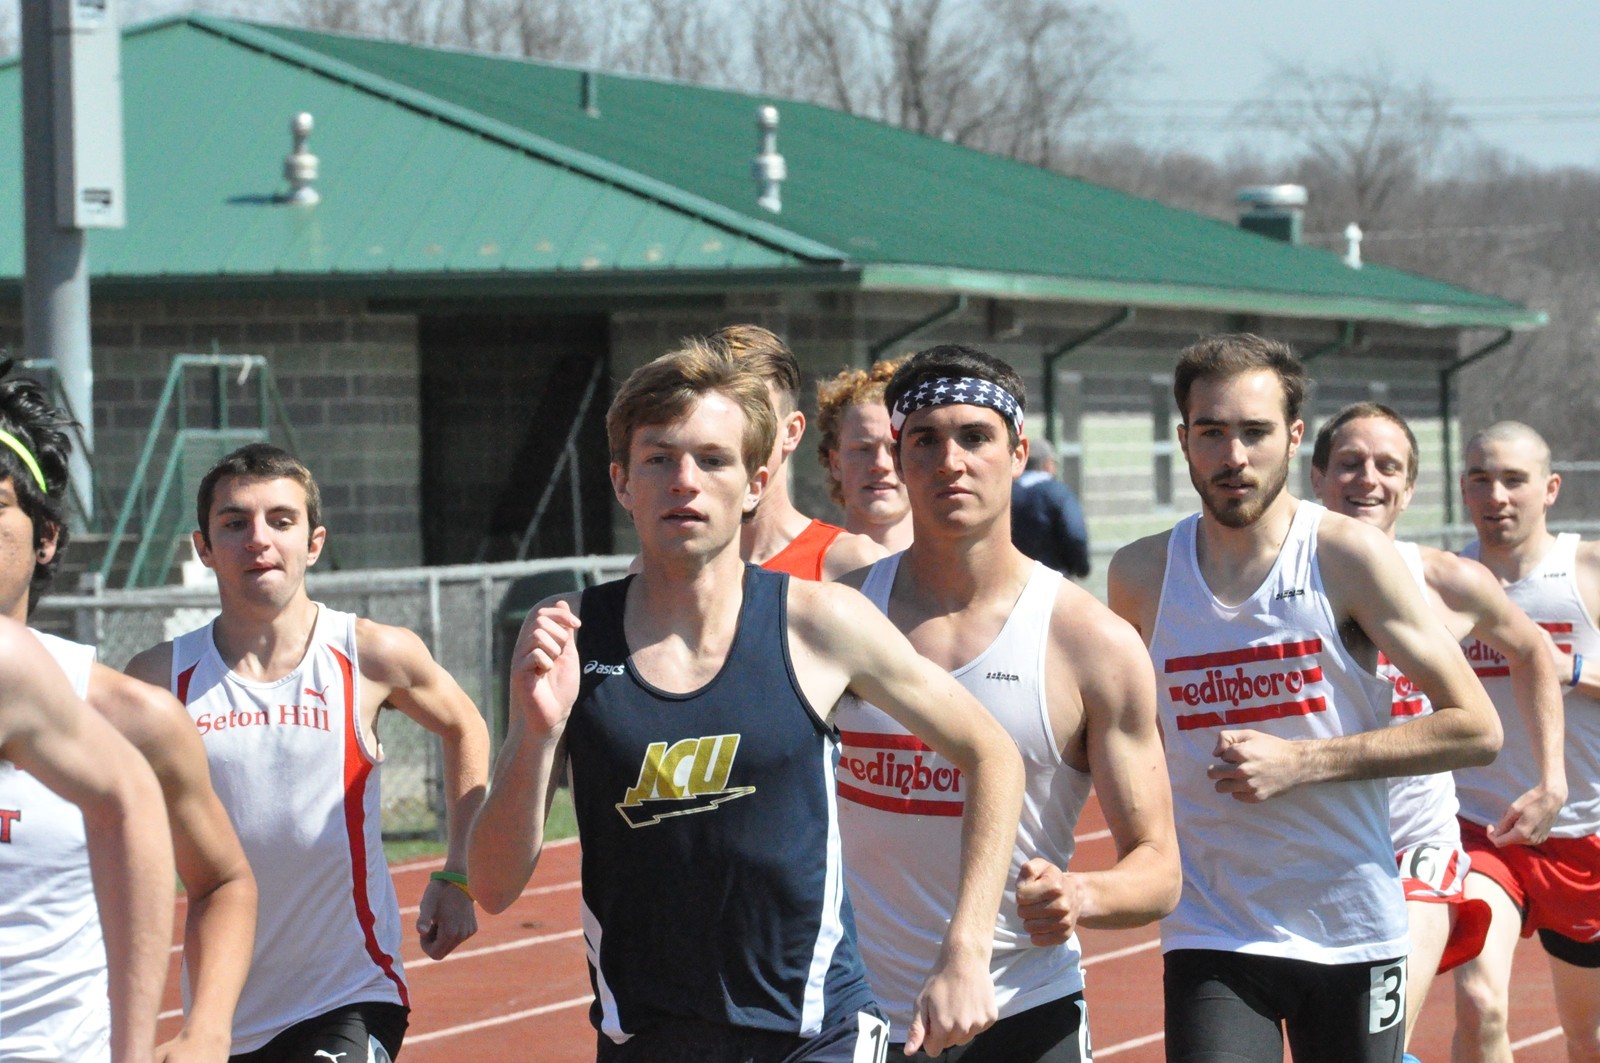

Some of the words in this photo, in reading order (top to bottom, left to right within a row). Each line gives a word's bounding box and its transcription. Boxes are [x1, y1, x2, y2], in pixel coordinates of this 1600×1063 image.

[596, 663, 625, 676] asics
[1182, 667, 1303, 707] edinboro
[195, 708, 270, 736] Seton
[278, 704, 331, 732] Hill
[624, 733, 741, 806] JCU
[1379, 966, 1402, 1028] 3
